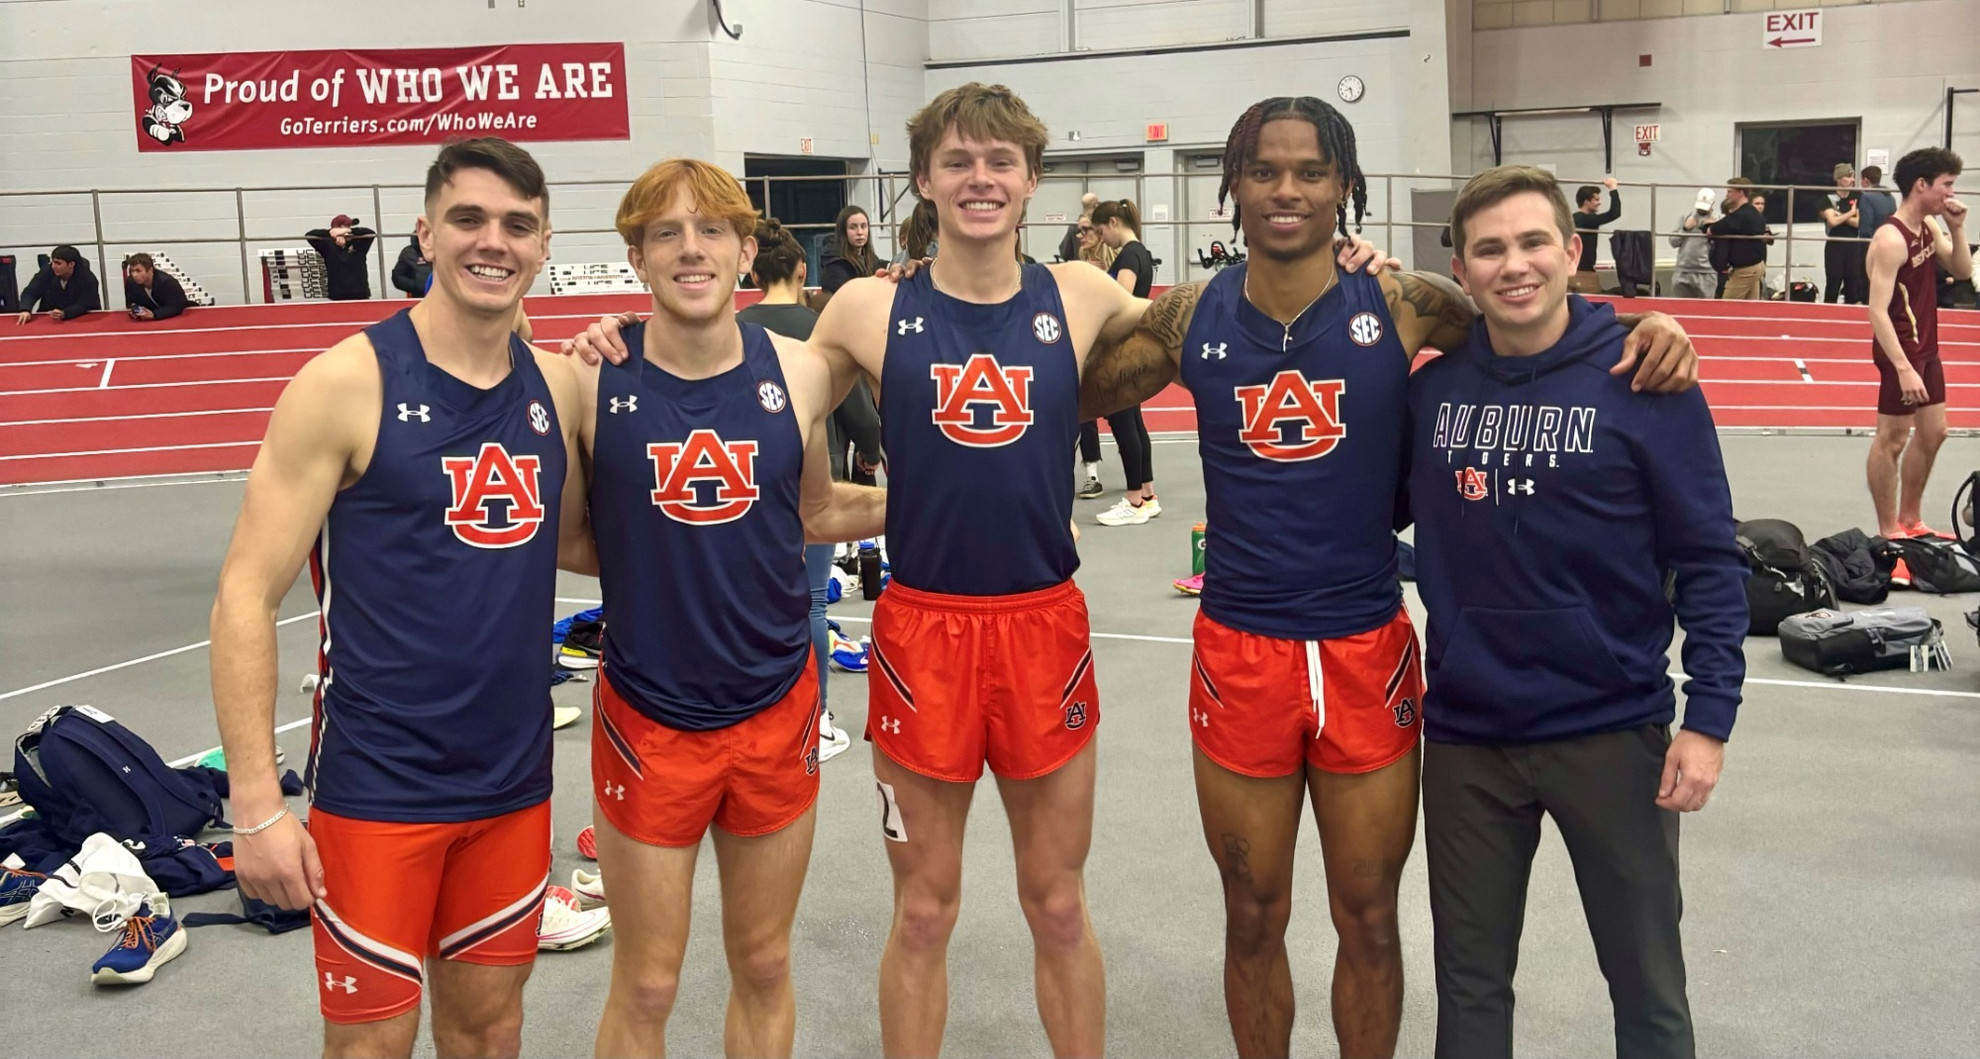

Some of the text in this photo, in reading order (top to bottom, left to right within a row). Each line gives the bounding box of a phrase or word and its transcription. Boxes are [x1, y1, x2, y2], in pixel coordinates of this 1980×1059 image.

[1767, 12, 1819, 32] EXIT
[204, 62, 613, 107] Proud of WHO WE ARE
[280, 111, 537, 136] GoTerriers.com/WhoWeAre
[1636, 125, 1659, 140] EXIT
[1034, 314, 1060, 342] SEC
[1350, 314, 1381, 344] SEC
[758, 382, 784, 411] SEC
[530, 402, 550, 433] SEC
[1432, 402, 1597, 453] AUBURN
